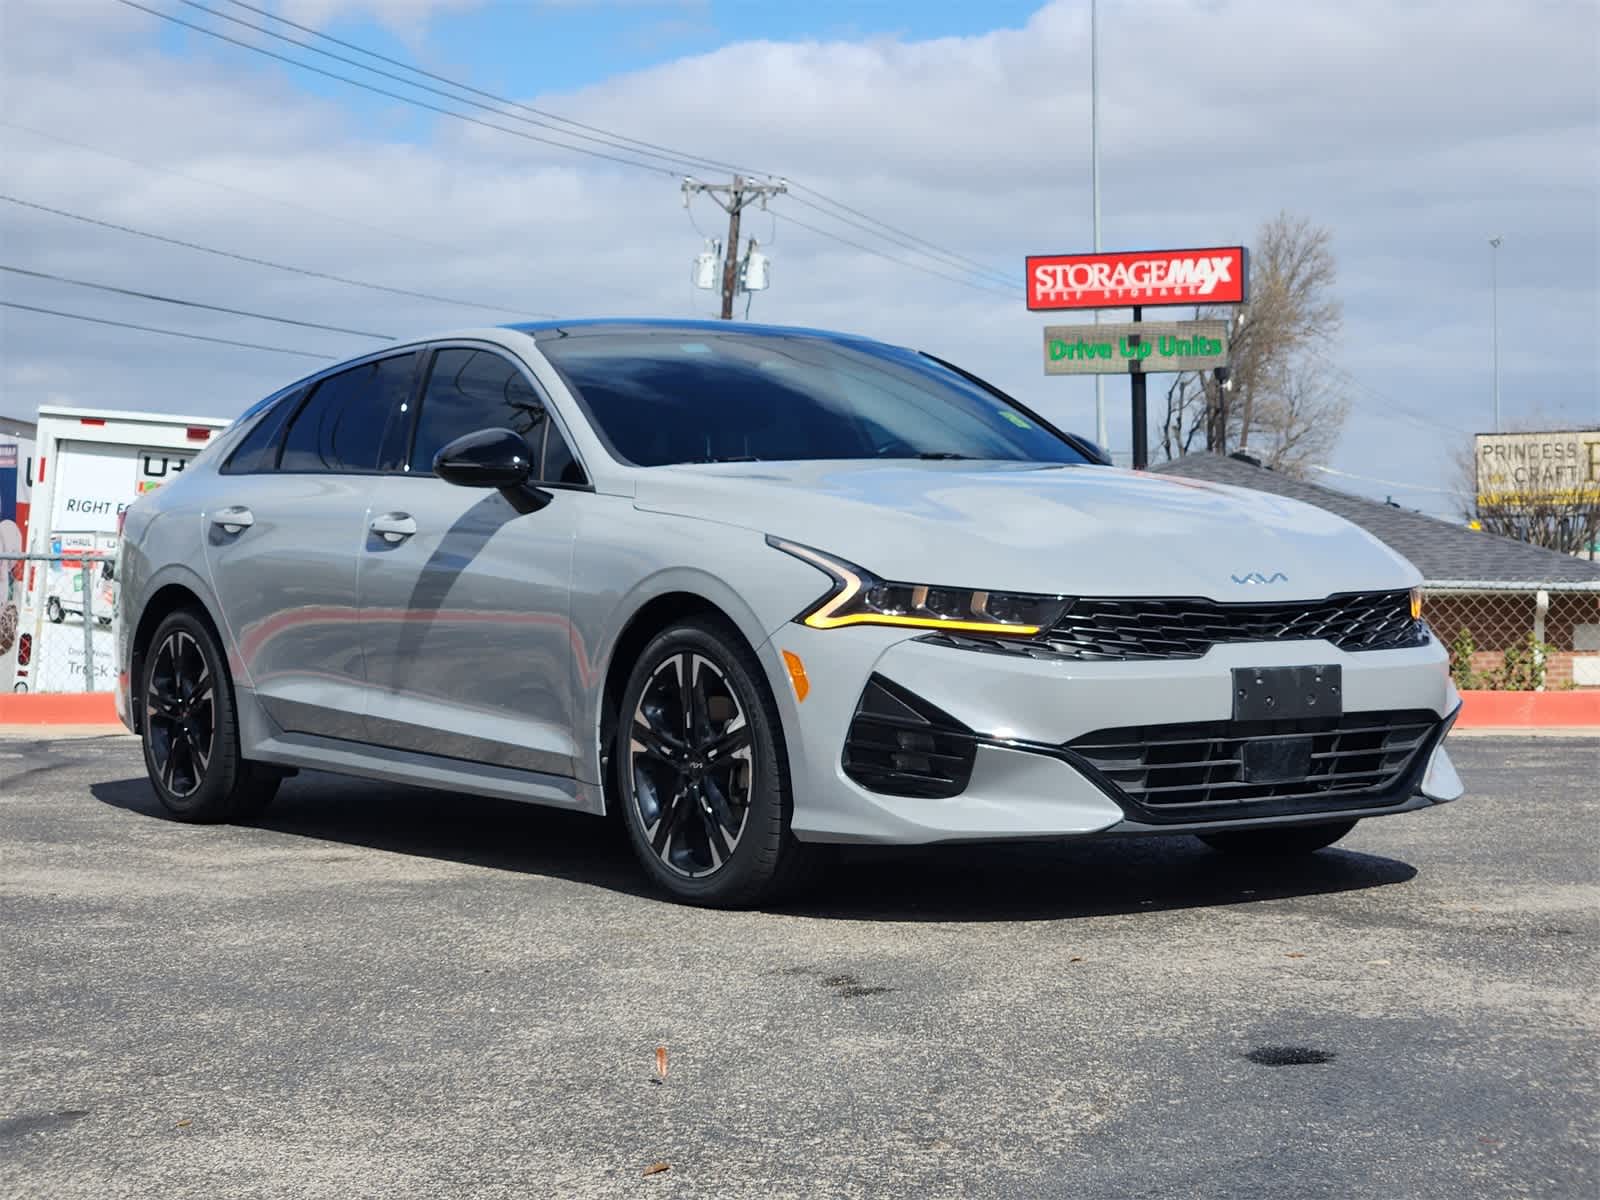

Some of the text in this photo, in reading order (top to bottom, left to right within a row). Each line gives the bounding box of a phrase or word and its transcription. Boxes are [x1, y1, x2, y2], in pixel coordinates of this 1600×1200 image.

[1050, 335, 1223, 361] Drive Up Units
[1482, 442, 1577, 461] PRINCESS
[1514, 464, 1577, 483] CRAFT
[66, 499, 112, 514] RIGHT
